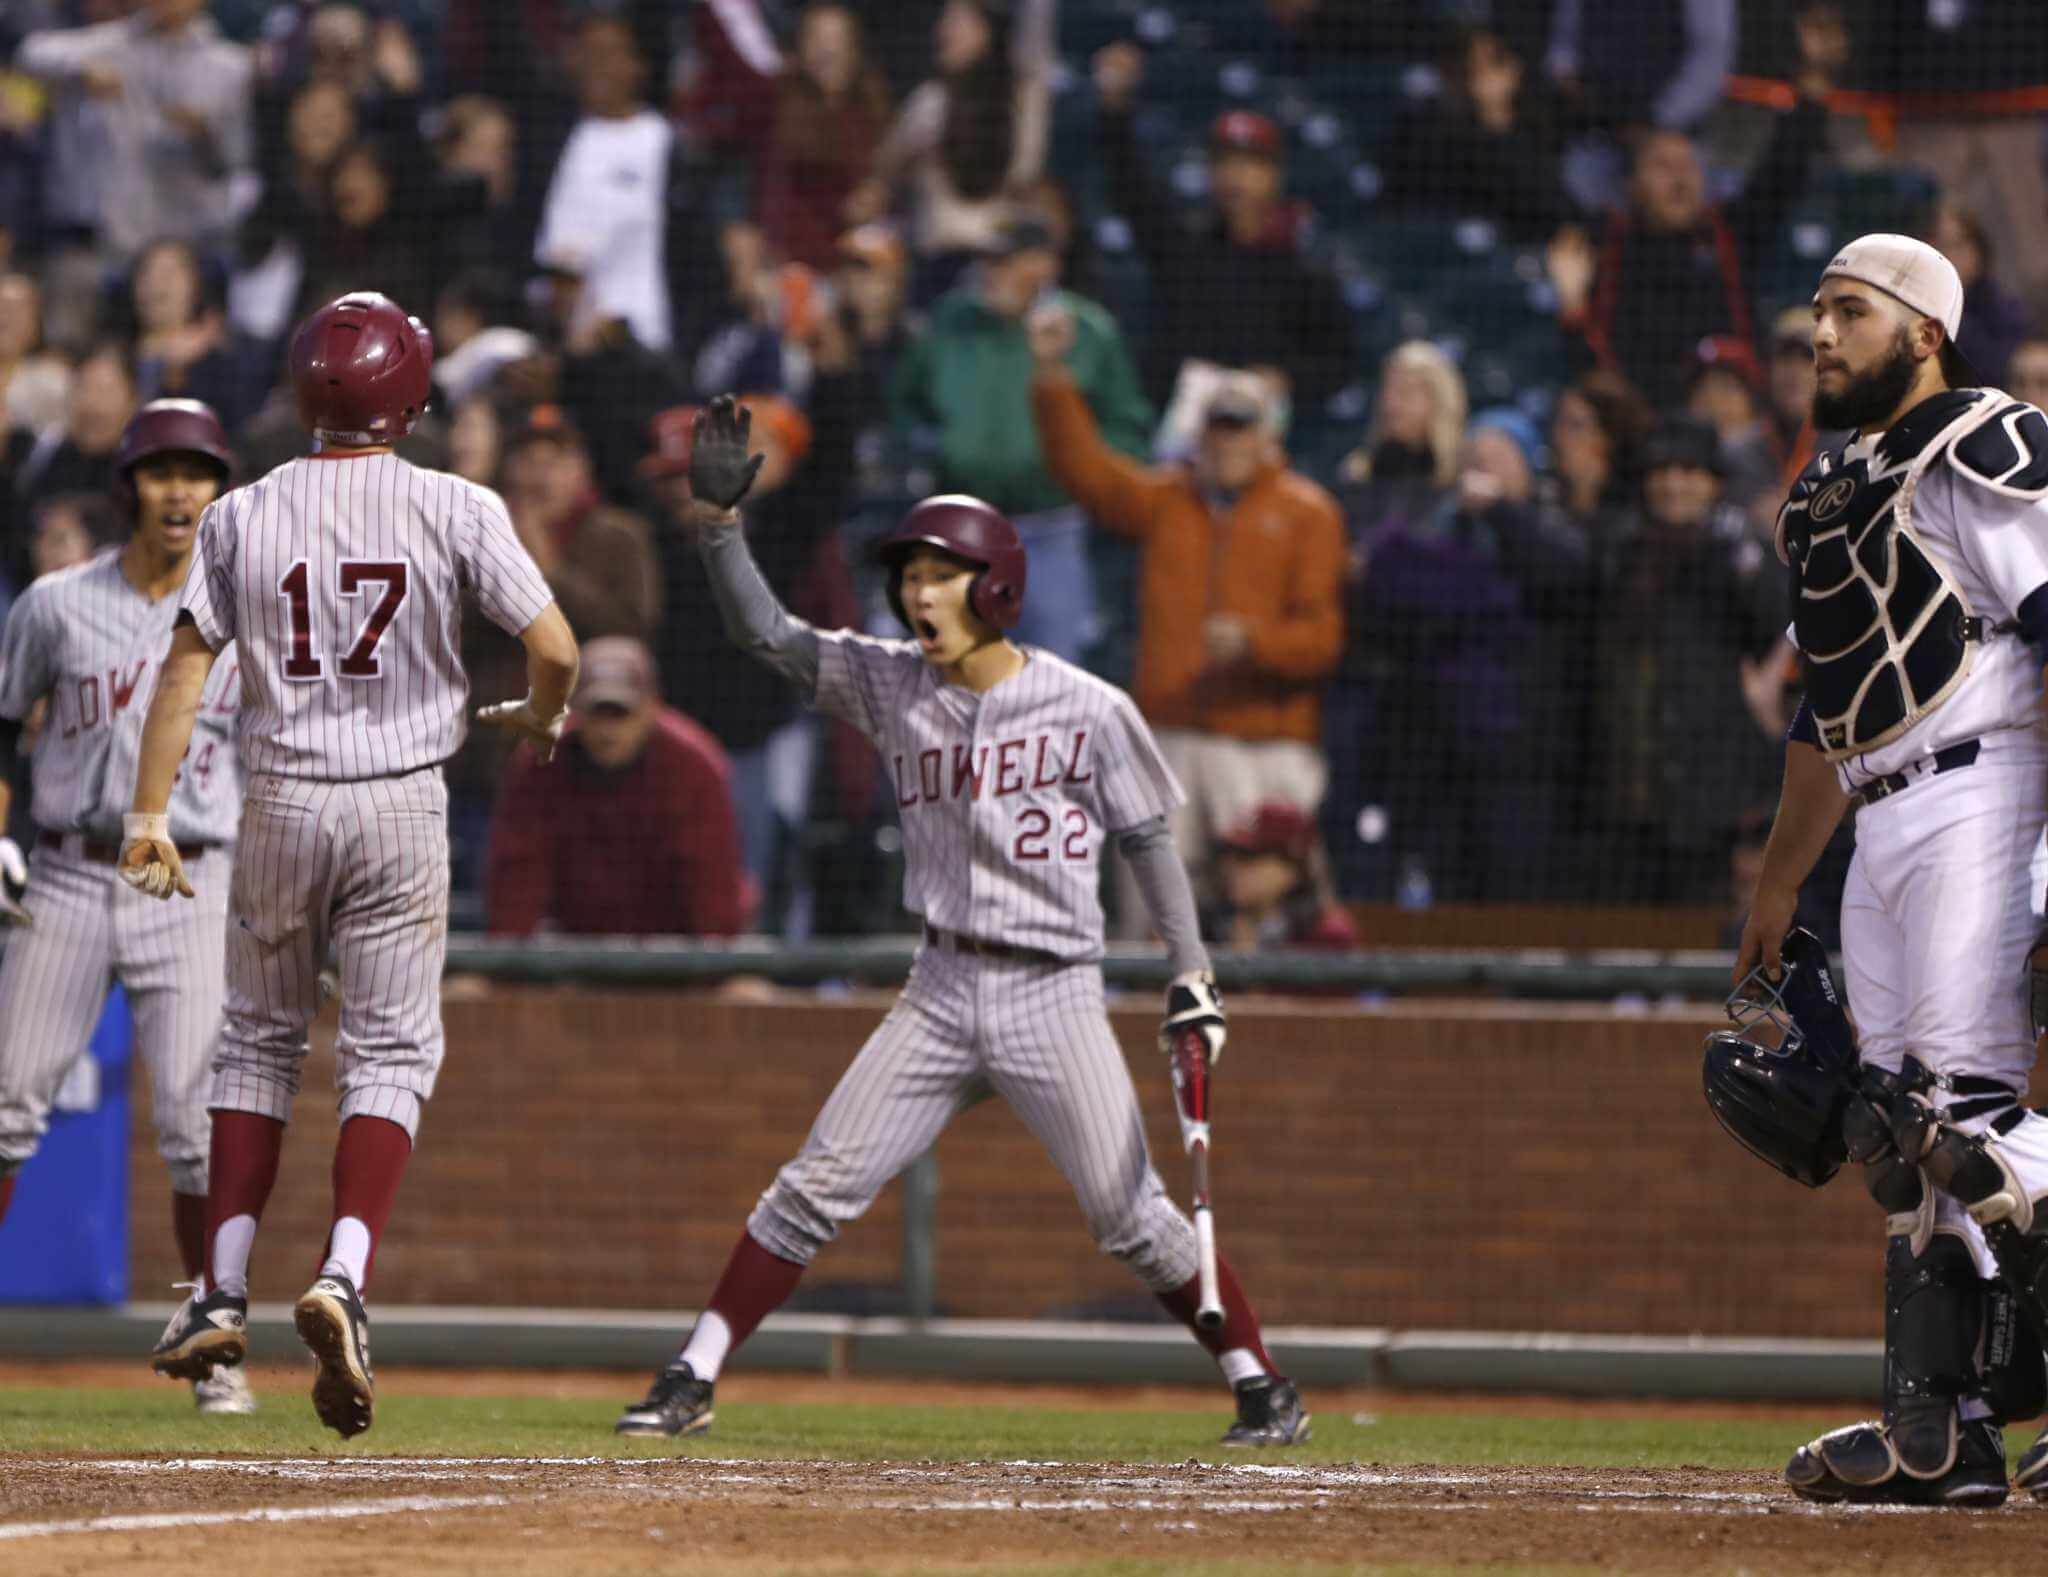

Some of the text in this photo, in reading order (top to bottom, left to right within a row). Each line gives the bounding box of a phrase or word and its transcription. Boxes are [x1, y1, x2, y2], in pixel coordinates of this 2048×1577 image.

[277, 558, 410, 680] 17
[57, 659, 239, 739] LOWL
[894, 731, 1091, 808] LOWELL
[1013, 808, 1089, 860] 22
